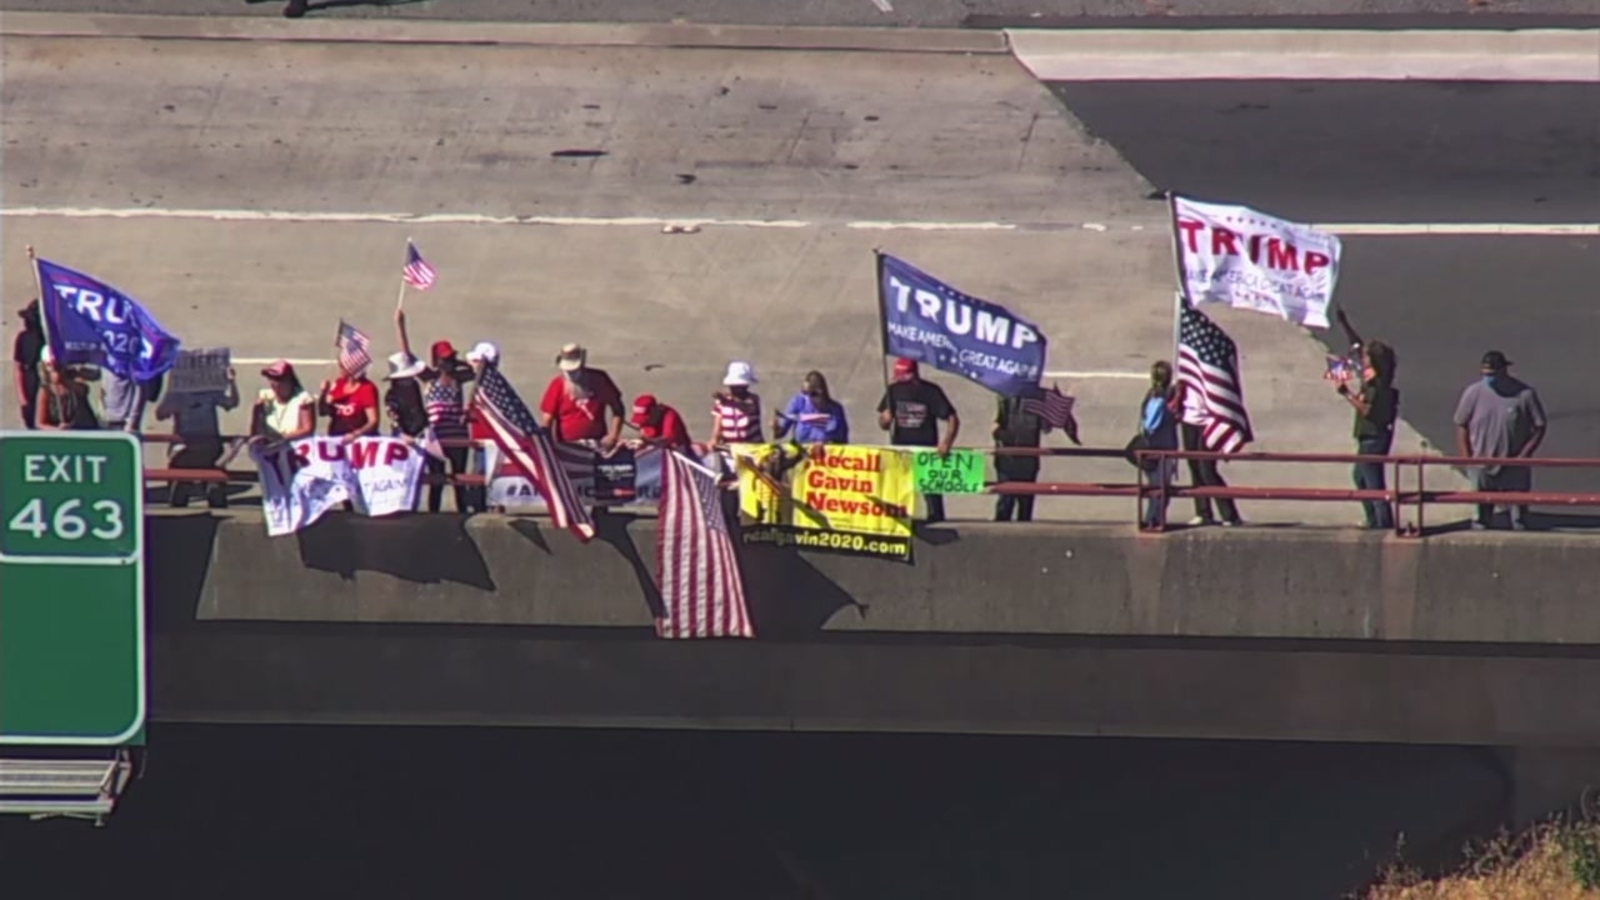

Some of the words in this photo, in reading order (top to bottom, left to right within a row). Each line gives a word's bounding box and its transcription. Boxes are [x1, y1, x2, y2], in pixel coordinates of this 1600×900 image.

[890, 275, 1038, 349] TRUMP
[888, 322, 917, 342] MAKE
[959, 349, 998, 369] GREAT
[24, 455, 106, 483] EXIT
[917, 451, 974, 471] OPEN
[808, 470, 873, 493] Gavin
[918, 478, 979, 493] SCHOOLS
[928, 469, 962, 481] OUR
[9, 498, 123, 539] 463
